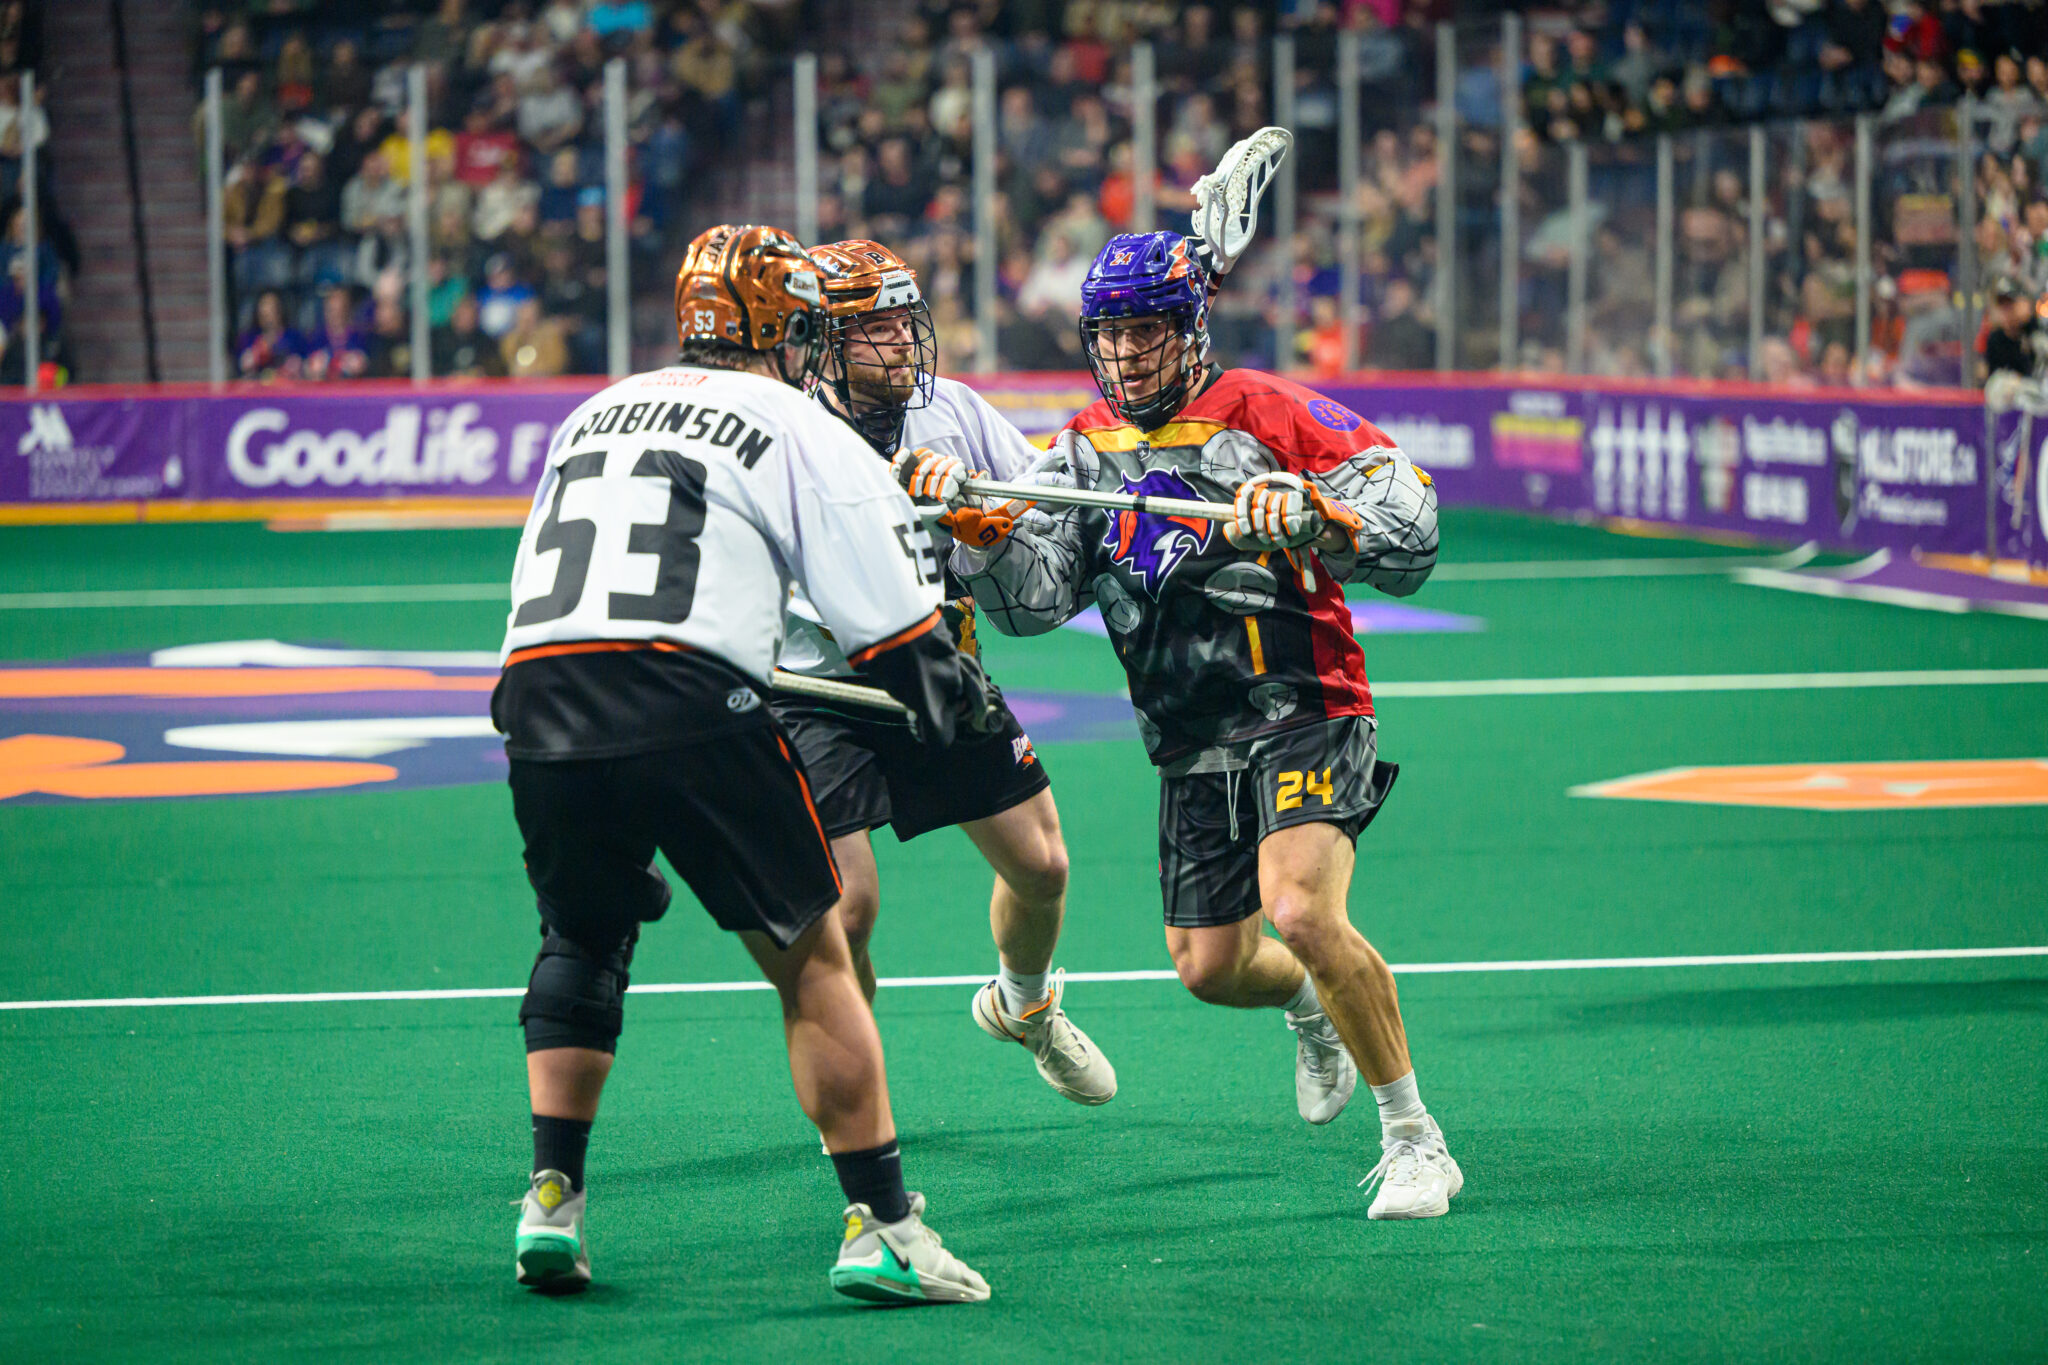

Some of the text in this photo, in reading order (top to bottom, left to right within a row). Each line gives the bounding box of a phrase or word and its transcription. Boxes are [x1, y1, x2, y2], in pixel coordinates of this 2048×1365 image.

[1109, 252, 1135, 266] 24
[694, 309, 715, 332] 53
[226, 403, 498, 487] GoodLife
[571, 402, 774, 470] ROBINSON
[513, 449, 708, 628] 53
[1276, 766, 1334, 812] 24
